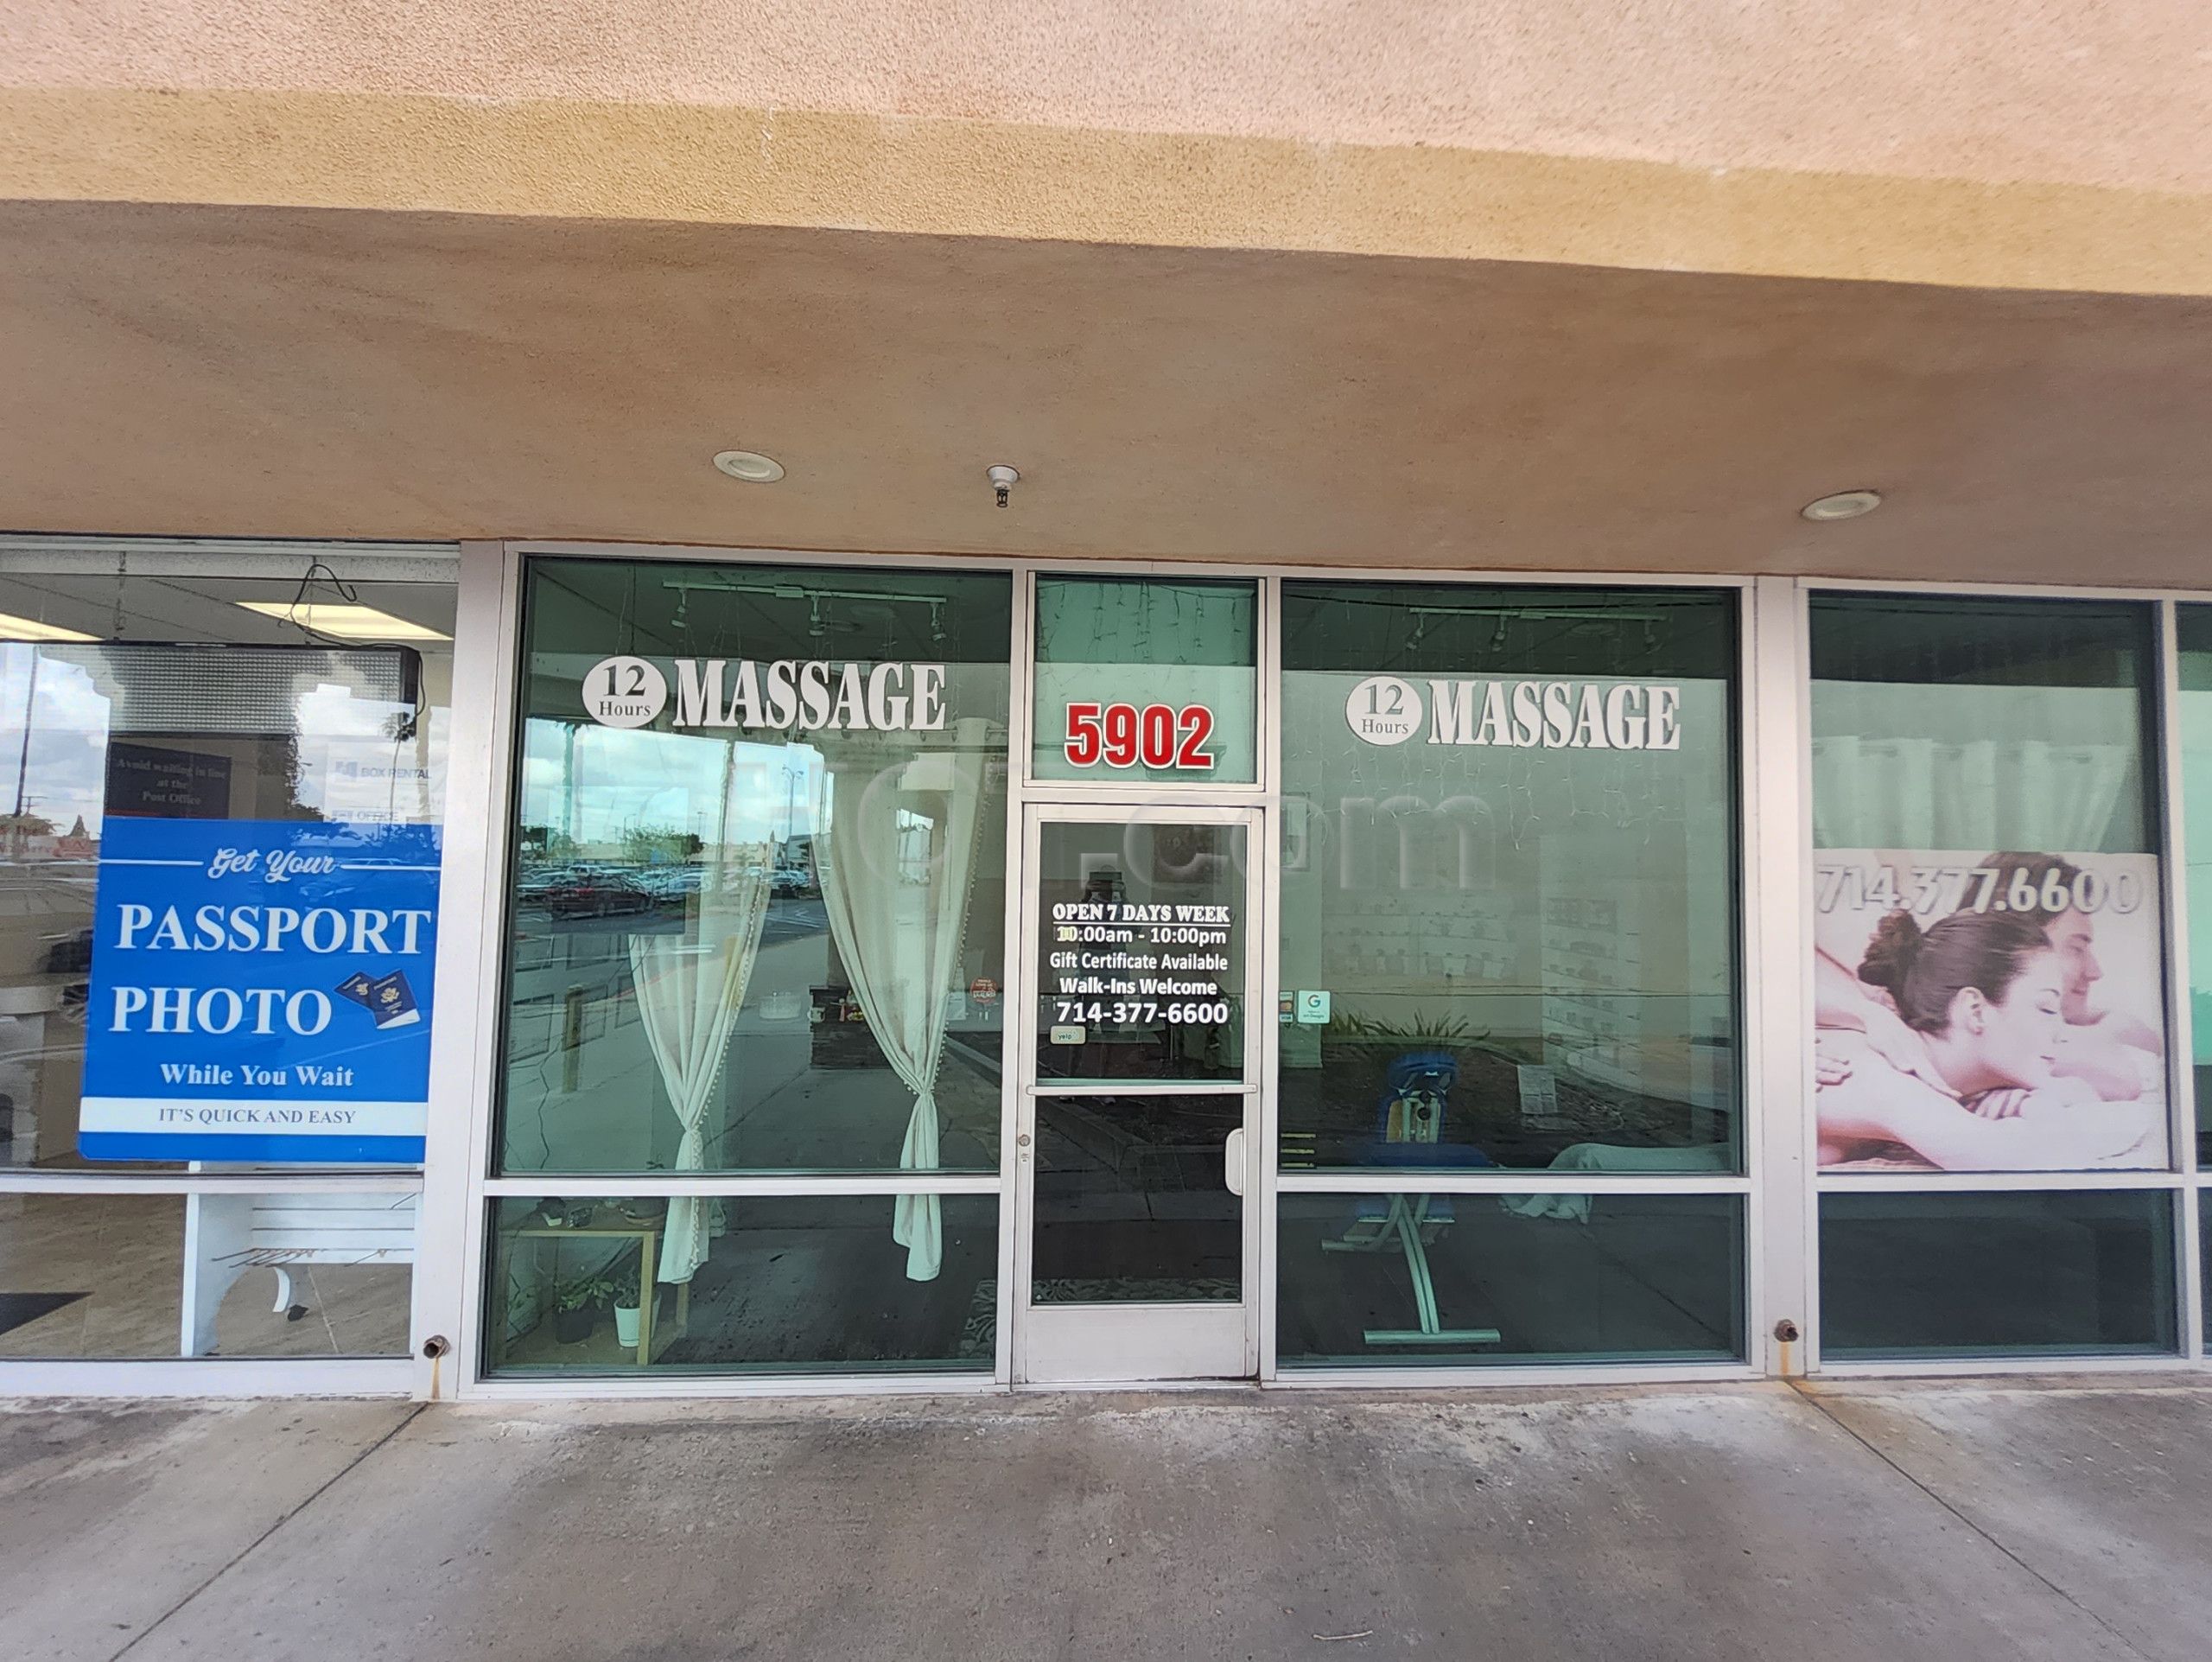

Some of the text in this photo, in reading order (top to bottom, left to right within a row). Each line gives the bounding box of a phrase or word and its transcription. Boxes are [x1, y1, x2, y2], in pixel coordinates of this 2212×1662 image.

[603, 665, 648, 697] 12
[672, 659, 947, 731] MASSAGE
[1363, 684, 1405, 716] 12
[598, 700, 652, 718] Hours
[1427, 679, 1682, 750] MASSAGE
[1064, 701, 1214, 770] 5902
[1361, 718, 1409, 735] Hours
[361, 767, 431, 779] BOX RENTAL
[207, 848, 338, 883] Get Your
[1818, 865, 2142, 914] 714.377.6600
[1052, 903, 1230, 923] OPEN 7 DAYS WEEK
[114, 904, 431, 954] PASSPORT
[1056, 926, 1133, 943] 10:00am
[1150, 927, 1226, 947] 10:00pm
[1050, 952, 1228, 971] Gift Certificate Available
[1059, 977, 1217, 995] Walk-Ins Welcome
[108, 986, 332, 1035] PHOTO
[1057, 1002, 1228, 1024] 714-377-6600
[162, 1063, 353, 1086] While You Wait
[199, 1108, 259, 1125] QUICK
[263, 1109, 304, 1124] AND
[309, 1110, 356, 1124] EASY
